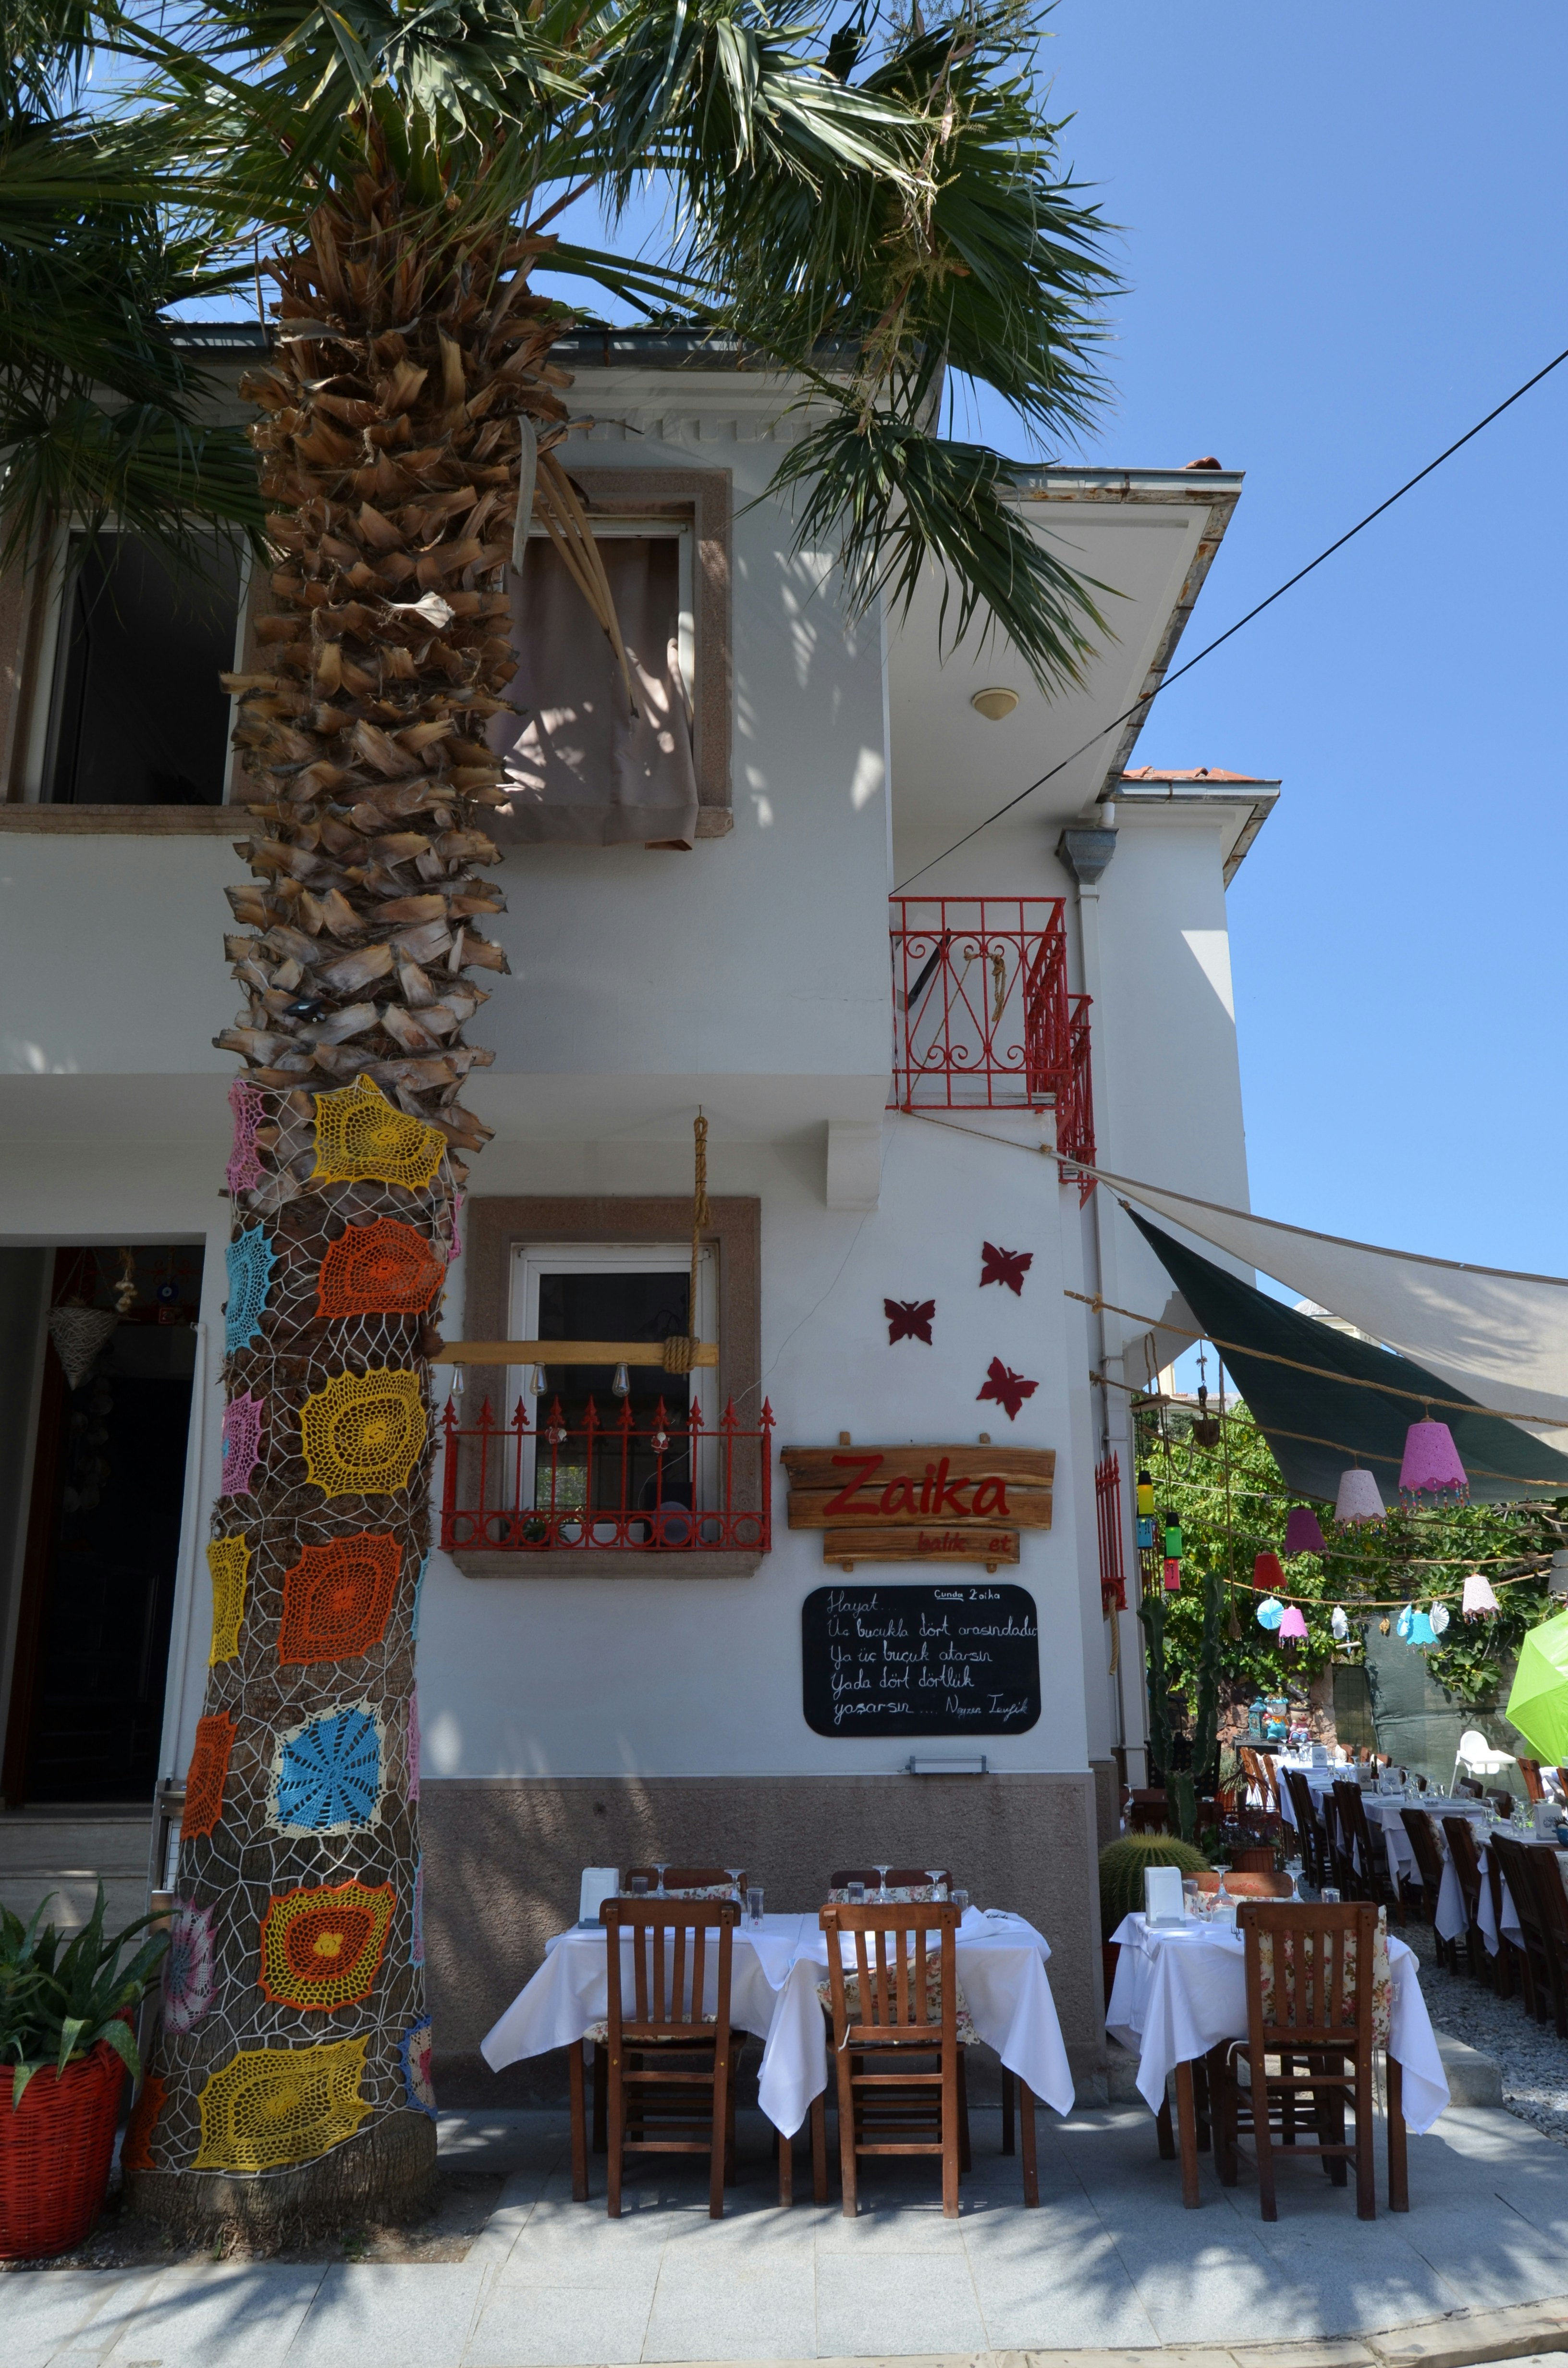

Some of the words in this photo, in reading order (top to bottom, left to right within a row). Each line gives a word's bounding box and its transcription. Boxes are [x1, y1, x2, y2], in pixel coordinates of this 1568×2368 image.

[823, 1455, 1010, 1516] Zaika
[989, 1535, 1012, 1552] et
[934, 1590, 964, 1599] Cunda
[968, 1588, 1001, 1600] Zaika
[919, 1612, 951, 1637] dört
[830, 1644, 852, 1670] Ya
[858, 1647, 877, 1663] üç
[883, 1640, 930, 1664] buçuk
[879, 1665, 910, 1689] dört
[919, 1664, 975, 1688] dörtlük
